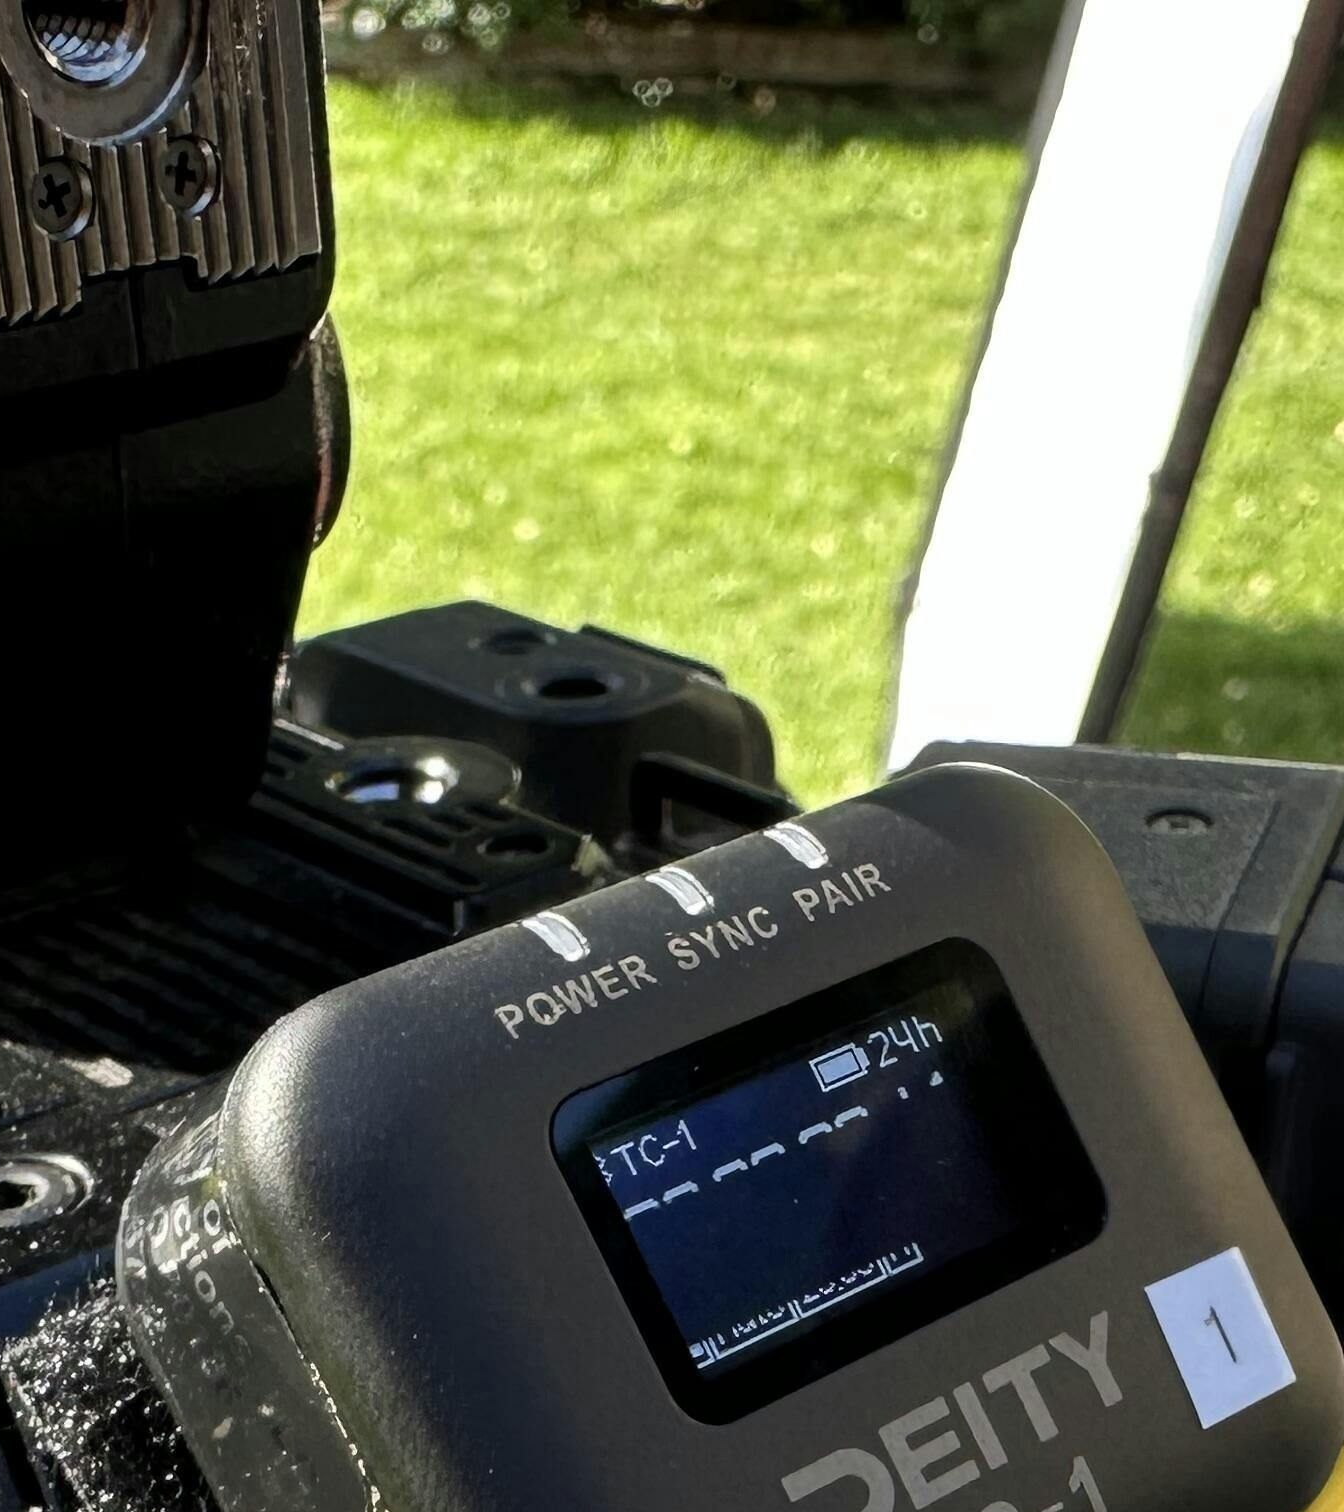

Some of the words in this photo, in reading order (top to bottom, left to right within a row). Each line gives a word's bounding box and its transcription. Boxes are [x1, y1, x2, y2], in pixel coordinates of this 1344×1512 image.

[494, 956, 658, 1041] POWER
[665, 904, 779, 974] SYNC
[792, 860, 893, 923] PAIR
[868, 1013, 945, 1069] 24h
[1203, 1304, 1239, 1364] 1
